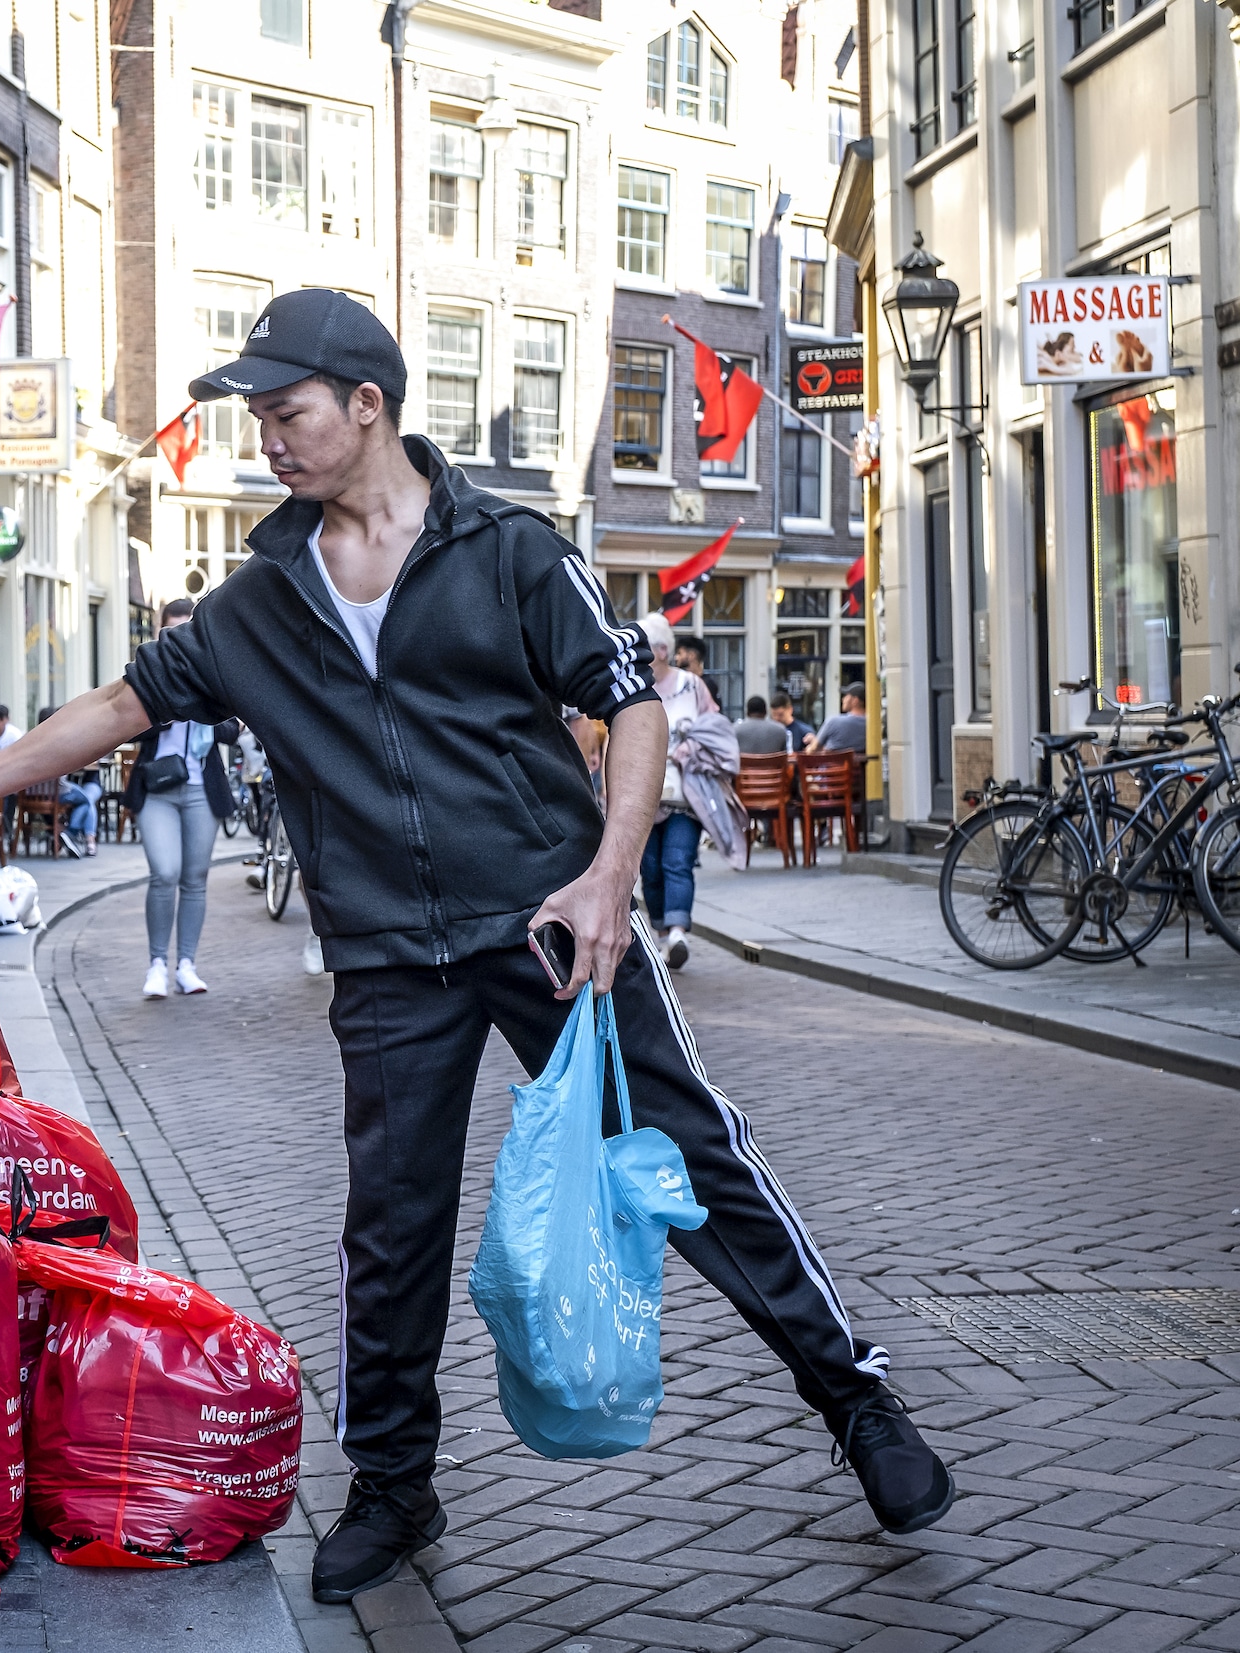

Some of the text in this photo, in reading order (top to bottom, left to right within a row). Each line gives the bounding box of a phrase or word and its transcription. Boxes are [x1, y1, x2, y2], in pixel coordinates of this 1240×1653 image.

[1029, 284, 1162, 324] MASSAGE
[1089, 341, 1105, 364] &
[221, 376, 254, 390] adidas
[201, 1405, 246, 1425] Meer
[194, 1468, 251, 1489] Vragen
[255, 1464, 279, 1481] over
